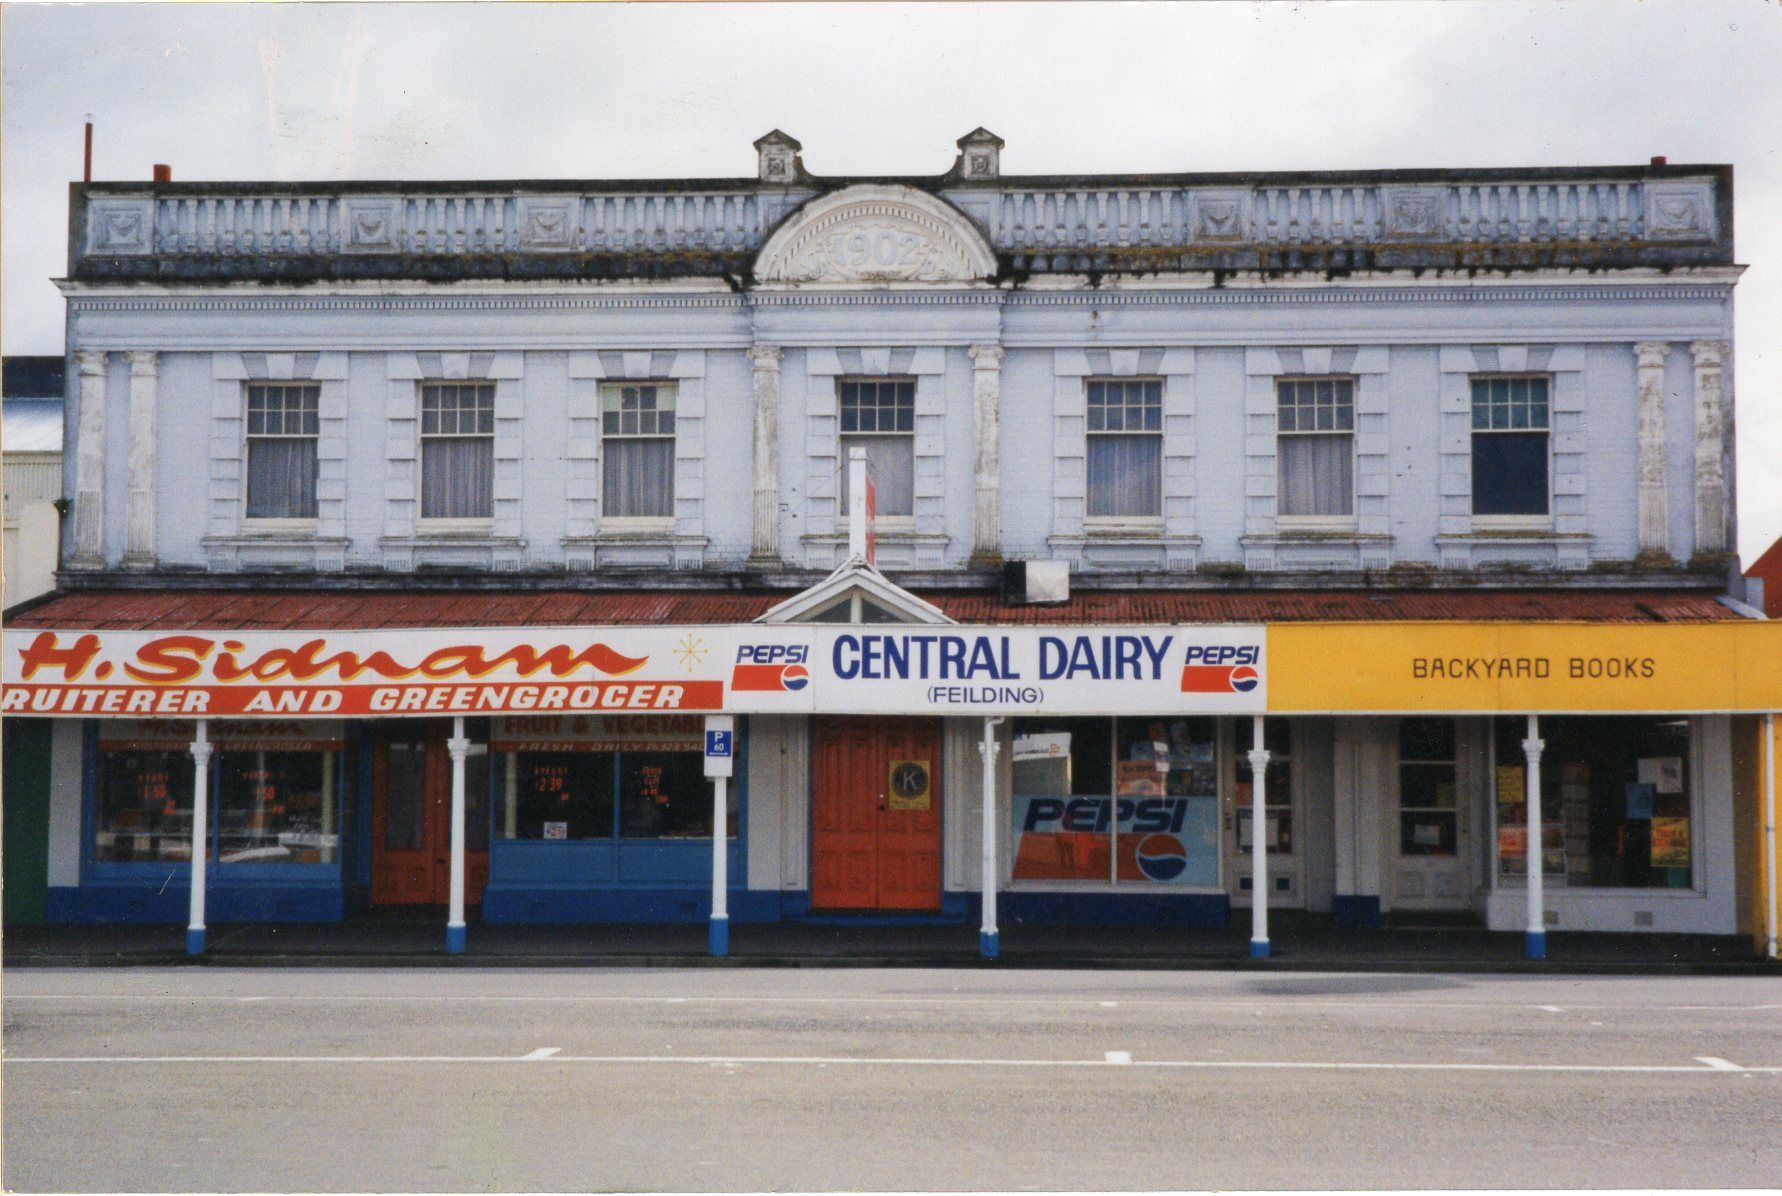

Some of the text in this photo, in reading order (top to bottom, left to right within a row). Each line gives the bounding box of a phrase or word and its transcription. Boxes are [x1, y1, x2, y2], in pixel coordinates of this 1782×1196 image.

[831, 231, 920, 265] 1902
[736, 644, 809, 664] PEPSI
[832, 634, 1173, 681] CENTRAL DAIRY
[1185, 645, 1260, 665] PEPSI
[1413, 657, 1655, 679] BACKYARD BOOKS
[2, 685, 684, 712] RUITERER AND GREENGROCER
[927, 686, 1044, 704] (FEILDING)
[504, 715, 706, 735] FRUIT & VEGETABL
[714, 731, 724, 742] P
[518, 742, 574, 752] FRESH
[591, 742, 643, 752] DAILY
[714, 743, 725, 752] 60
[903, 772, 919, 791] K
[1023, 797, 1188, 834] PEPSI
